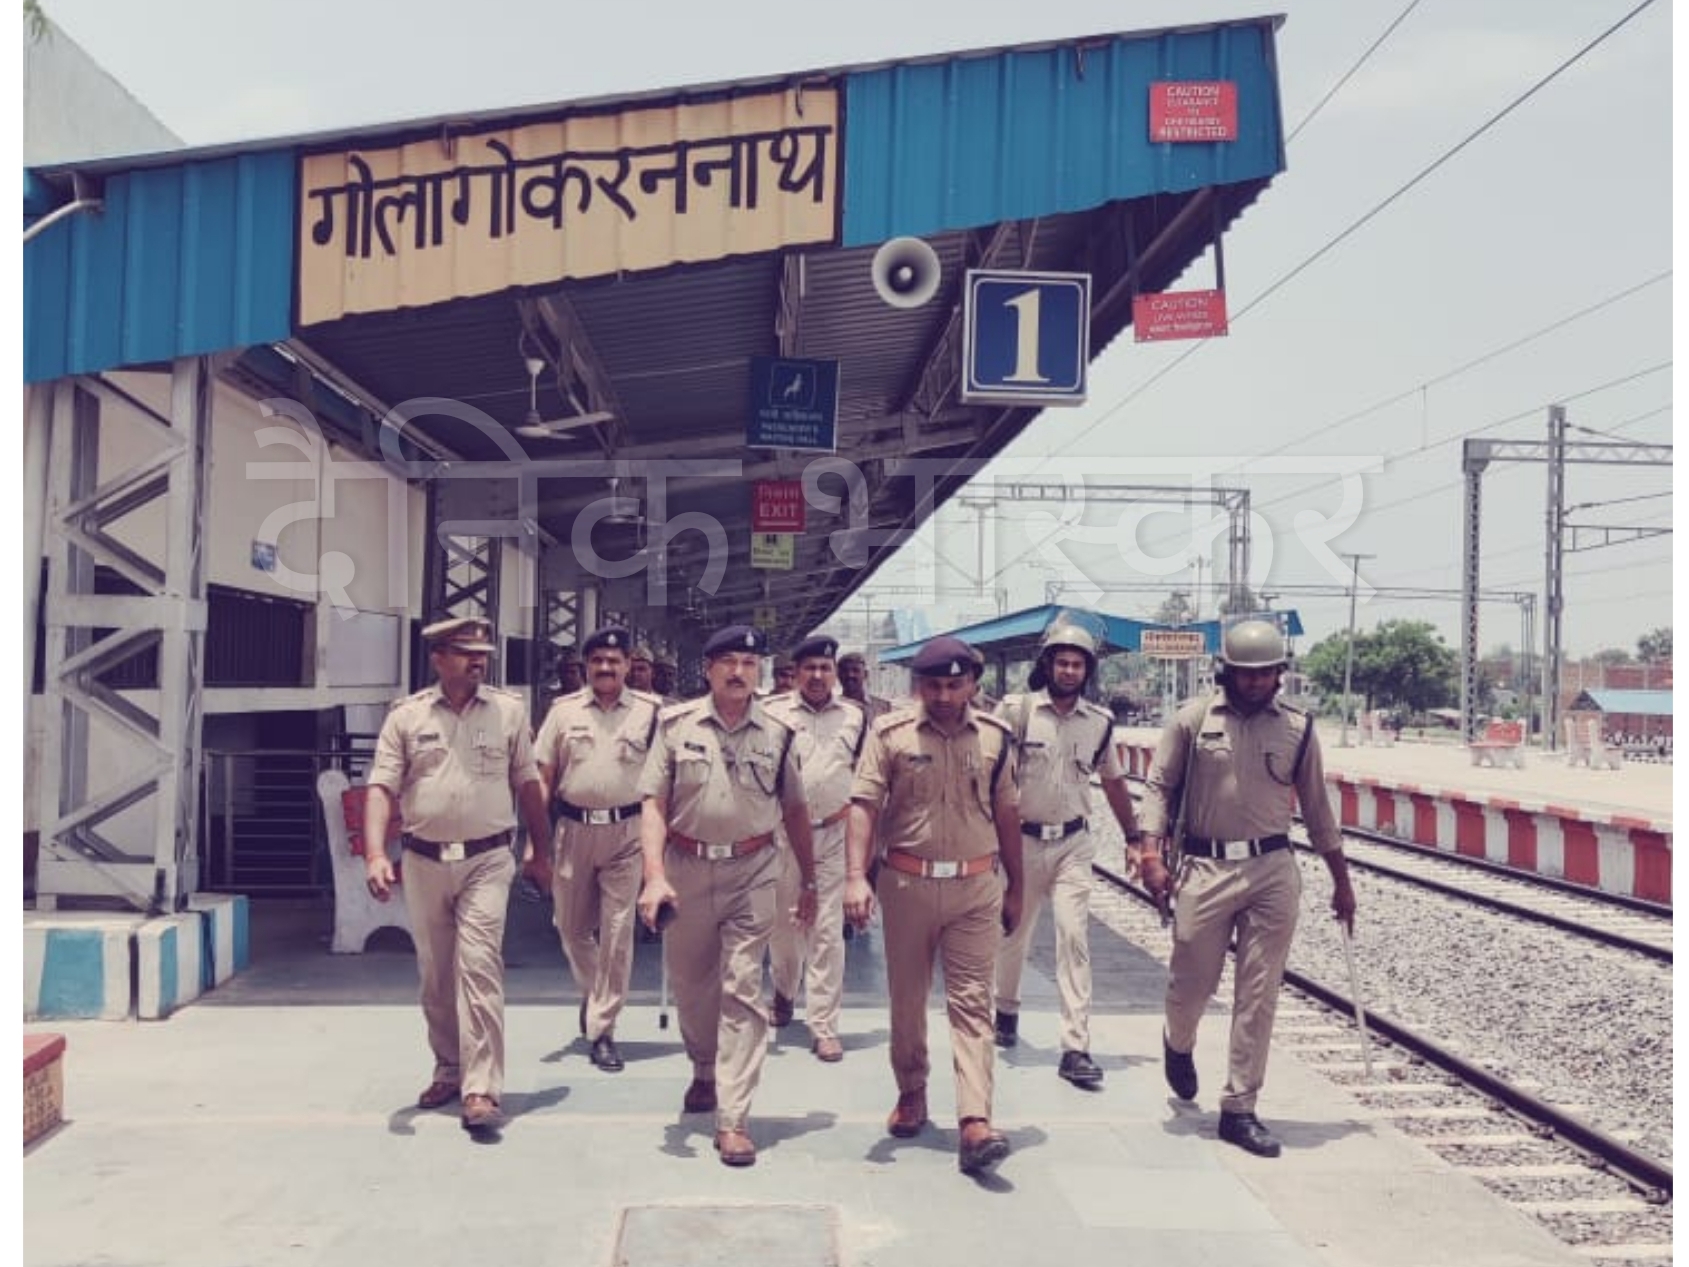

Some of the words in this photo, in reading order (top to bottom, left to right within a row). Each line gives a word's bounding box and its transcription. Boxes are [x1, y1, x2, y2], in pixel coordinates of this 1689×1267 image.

[1166, 86, 1219, 96] CAUTION
[1151, 298, 1208, 310] CAUTION
[1002, 288, 1050, 382] 1
[760, 503, 796, 517] EXIT
